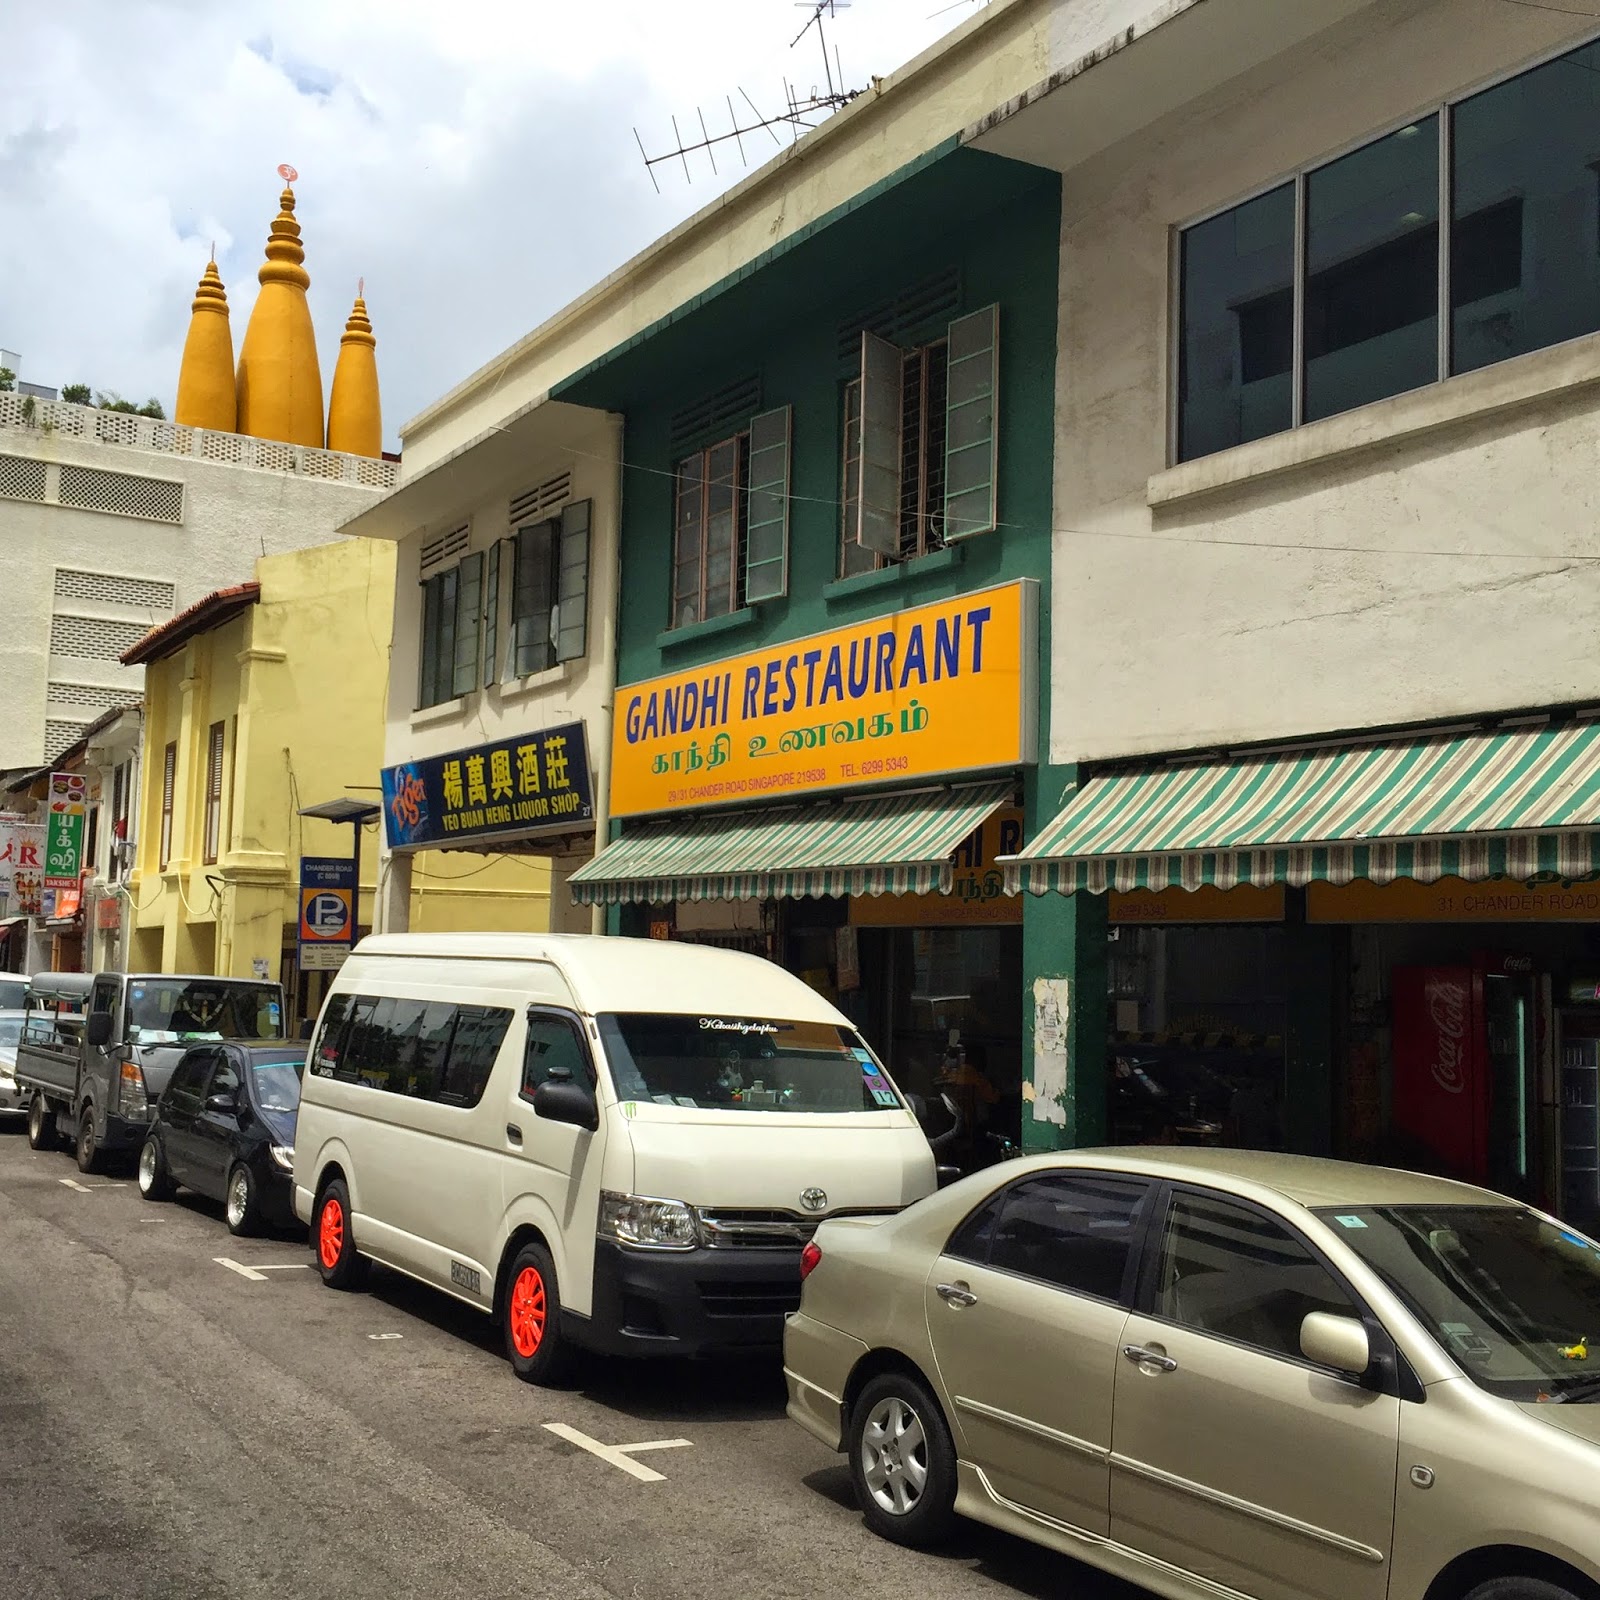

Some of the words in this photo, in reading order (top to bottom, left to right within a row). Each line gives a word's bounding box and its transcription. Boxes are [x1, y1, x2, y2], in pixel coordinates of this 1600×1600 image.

[626, 673, 731, 744] GANDHI
[741, 607, 991, 721] RESTAURANT
[651, 732, 731, 775] காந்தி
[748, 699, 929, 758] உணவகம்
[442, 735, 570, 811] 楊萬興酒莊
[689, 783, 725, 800] CHANDER
[725, 780, 747, 794] ROAD
[748, 772, 795, 791] SINGAPORE
[797, 768, 826, 784] 219538
[861, 760, 884, 775] 6299
[885, 756, 909, 771] 5343
[442, 813, 460, 832] YEO
[461, 809, 485, 828] BUAN
[486, 806, 511, 826] HENG
[513, 799, 549, 821] LIQUOR
[551, 792, 580, 814] SHOP
[582, 806, 591, 817] 27
[20, 846, 41, 865] R
[305, 864, 334, 872] CHANDER
[335, 864, 353, 873] ROAD
[1463, 895, 1543, 911] CHANDER
[1549, 893, 1600, 910] ROAD
